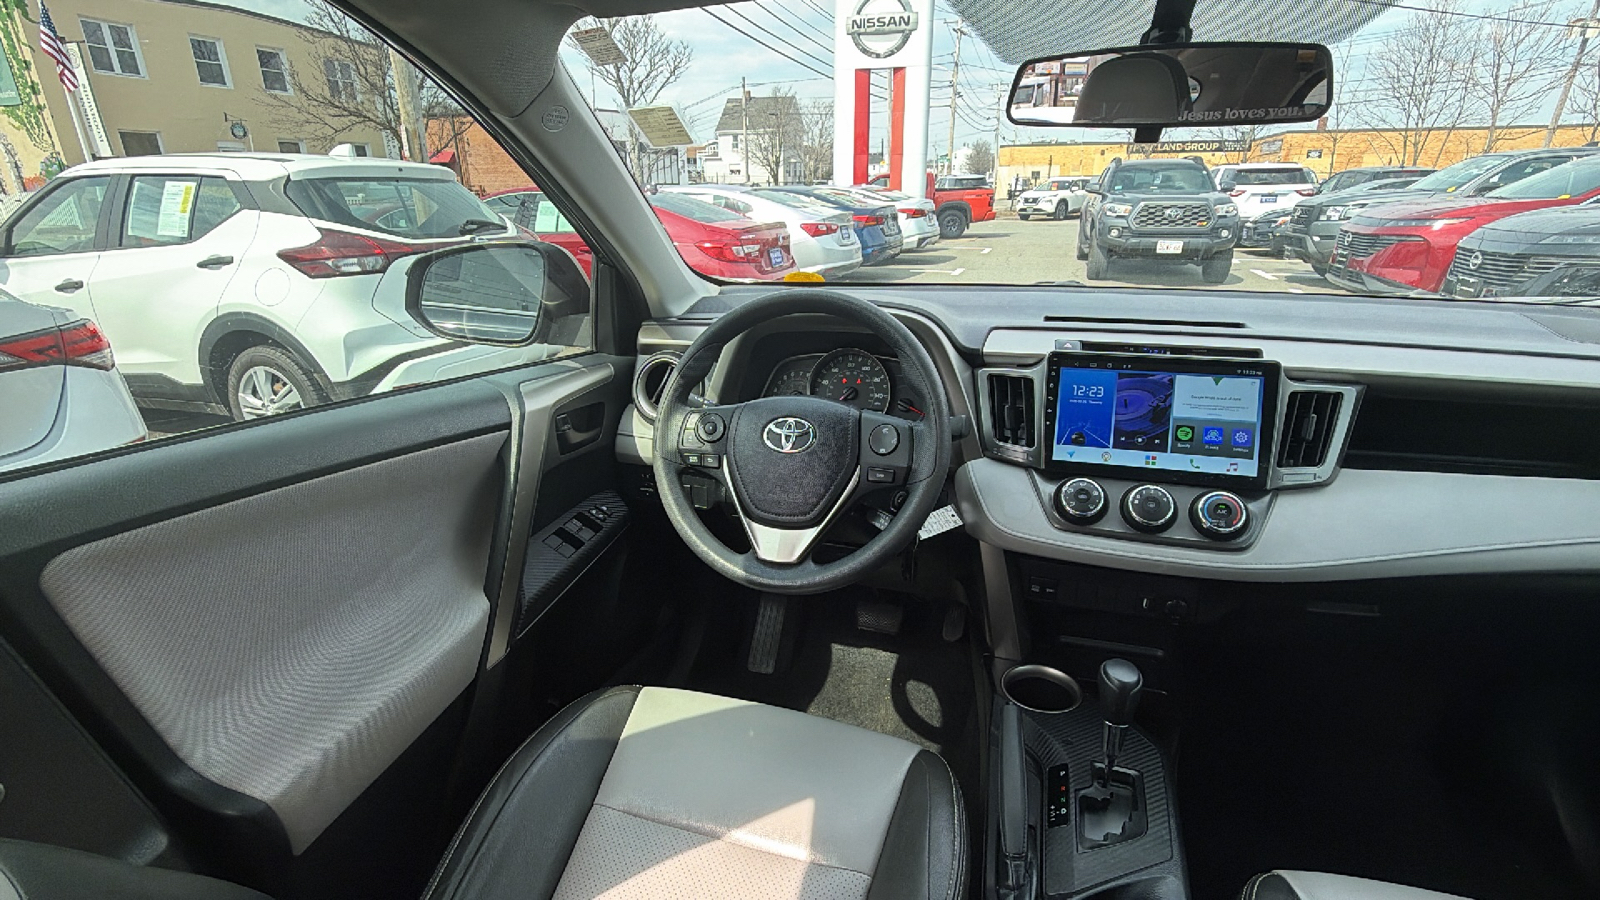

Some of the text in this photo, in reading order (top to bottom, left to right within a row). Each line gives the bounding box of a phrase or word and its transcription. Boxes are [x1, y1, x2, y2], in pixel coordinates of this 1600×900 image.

[851, 15, 910, 29] NISSAN
[1178, 106, 1303, 121] Jesus loves you.
[1184, 141, 1219, 151] GROUP
[1073, 384, 1104, 397] 12:23
